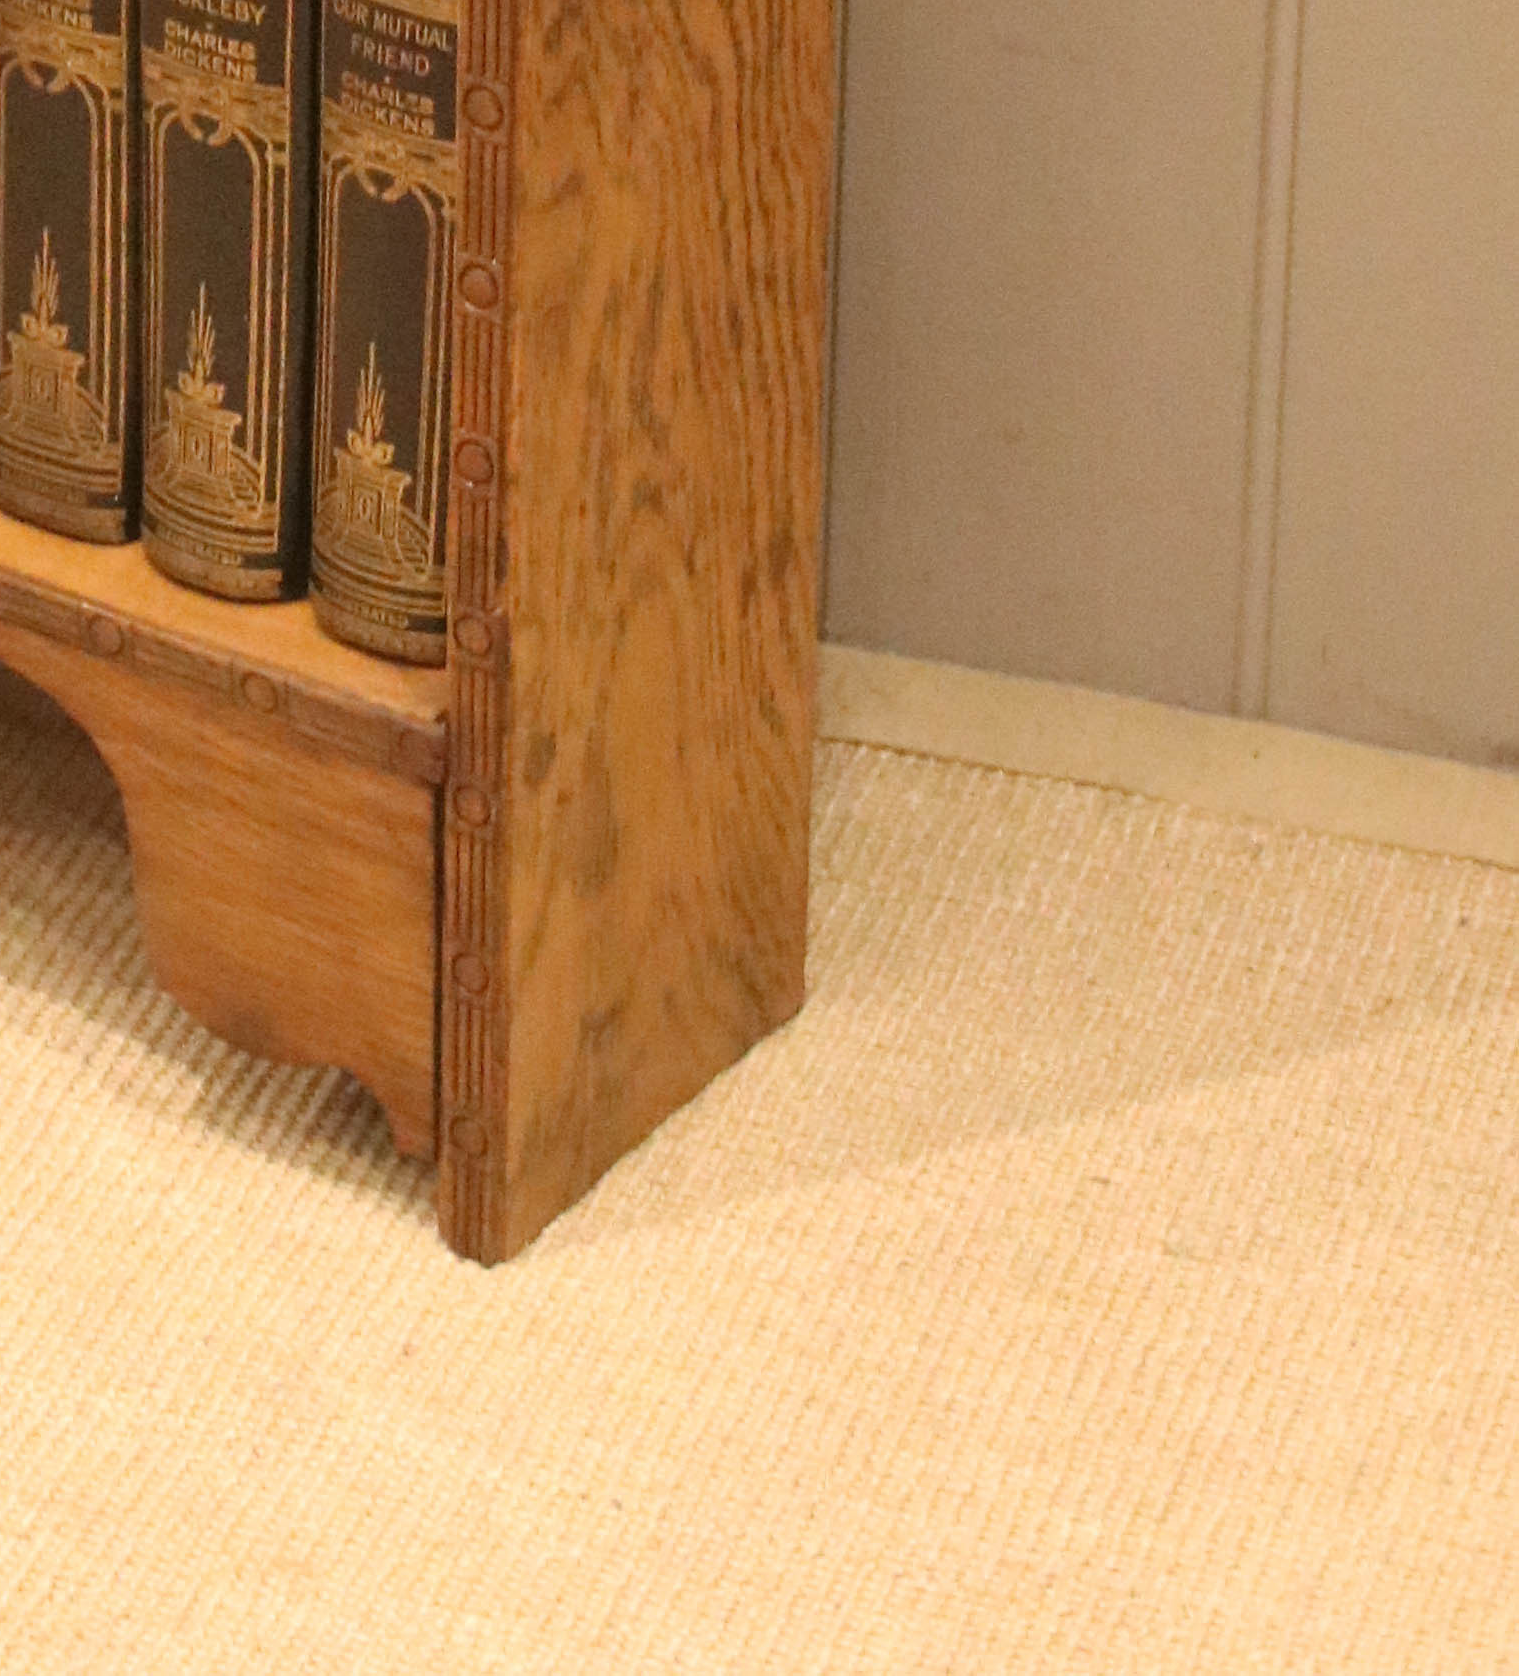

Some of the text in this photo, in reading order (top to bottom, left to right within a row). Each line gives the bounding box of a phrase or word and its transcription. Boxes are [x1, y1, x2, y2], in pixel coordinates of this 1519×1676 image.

[164, 19, 256, 60] CHARLES
[372, 9, 453, 52] MUTUAL
[163, 42, 257, 84] DICKENS
[350, 33, 431, 78] FRIEND
[339, 93, 435, 137] DICKENS
[340, 72, 435, 115] CHARLES
